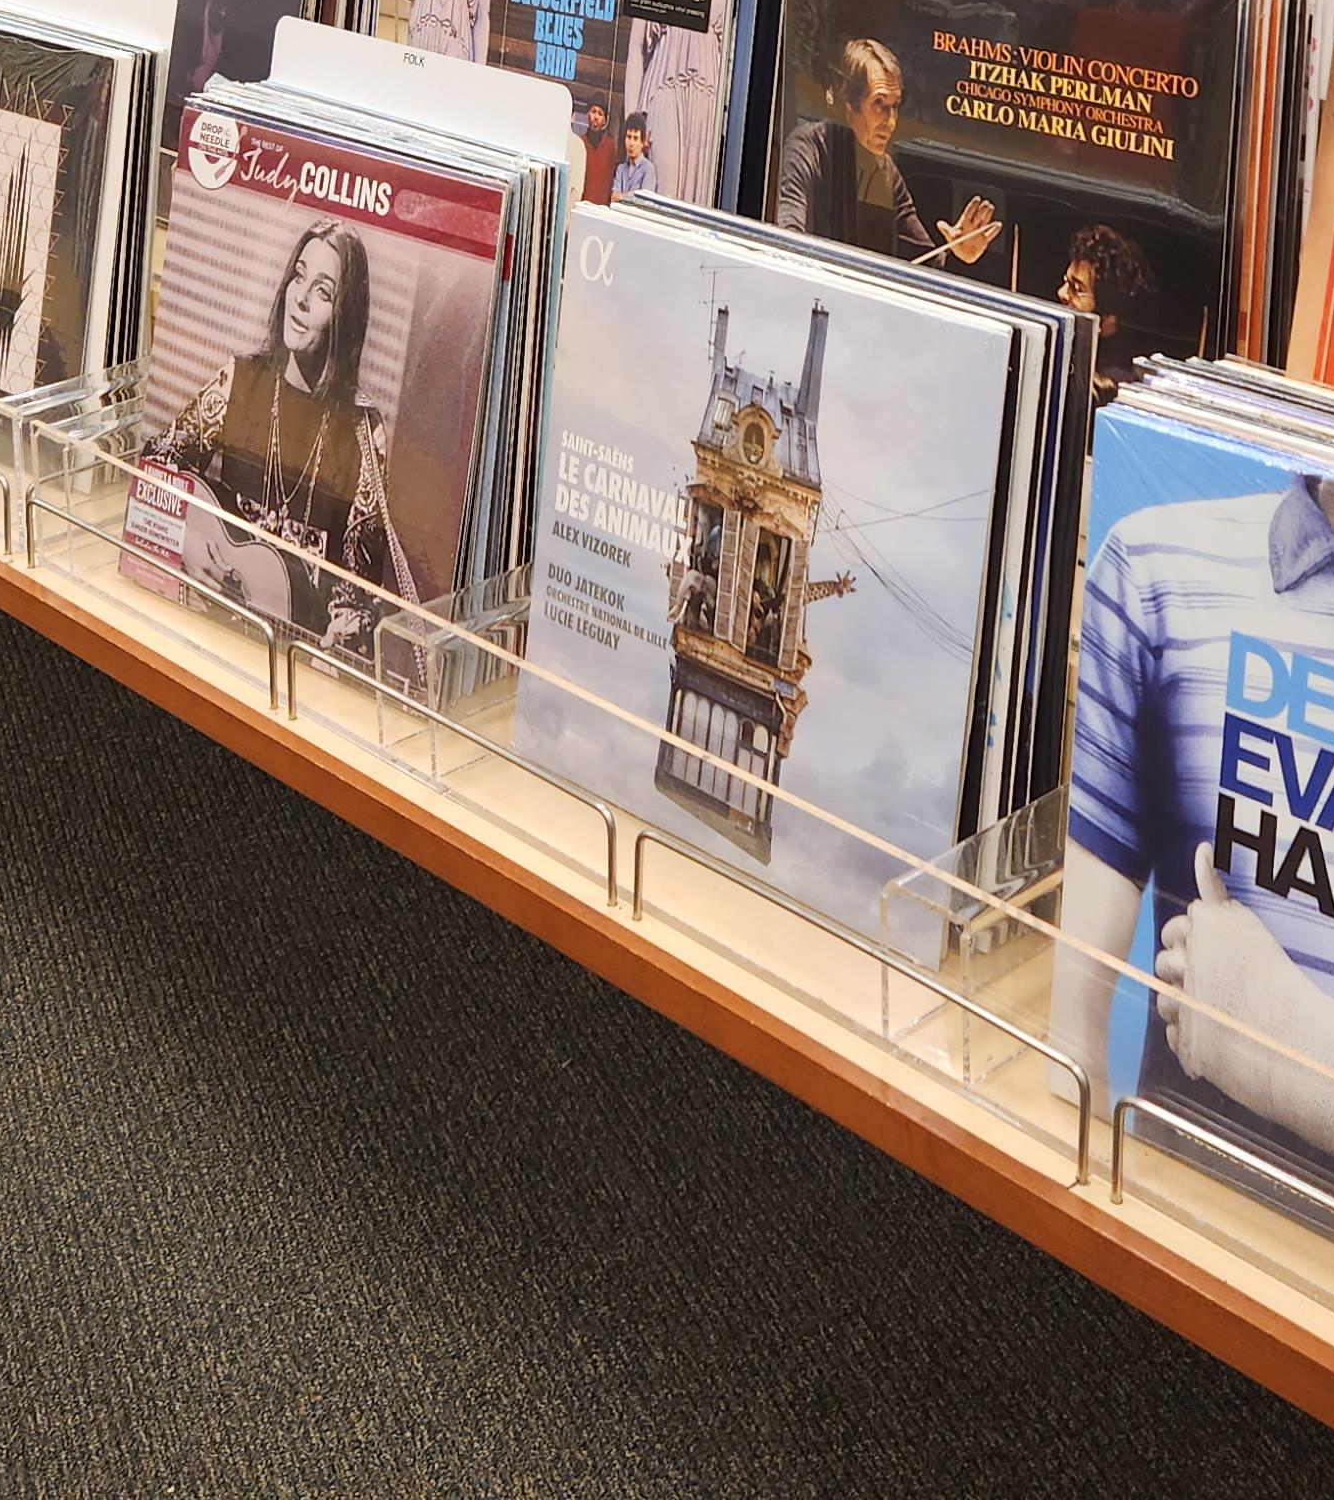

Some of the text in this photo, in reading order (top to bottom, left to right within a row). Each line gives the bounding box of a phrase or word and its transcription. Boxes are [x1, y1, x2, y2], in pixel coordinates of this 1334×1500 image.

[532, 9, 585, 51] BLUES
[402, 51, 426, 69] FOLK
[533, 42, 578, 82] BAND
[1018, 45, 1200, 99] VIOLIN CONCERTO
[956, 79, 1165, 135] CHICAGO SYMPHONY ORCHESTRA
[969, 59, 1154, 115] ITZHAK PERLMAN
[199, 133, 231, 150] NEEDLE
[200, 122, 224, 136] DROP
[250, 137, 275, 150] THE BEST
[945, 94, 1176, 162] CARLO MARIA GIULINI
[240, 147, 393, 217] Judy COLLINS
[561, 430, 635, 474] SAINT-SAËNS
[136, 480, 183, 517] EXCLUSIVE
[558, 451, 689, 531] LE CARNAVAL
[552, 520, 632, 569] ALEX VIZOREK
[554, 483, 694, 567] DES ANIMAUX
[547, 562, 625, 613] DUO JATEKOK
[543, 605, 621, 651] LUCIE LEGUAY
[546, 584, 668, 651] ORCHESTRE NATIONAL DE LILLE
